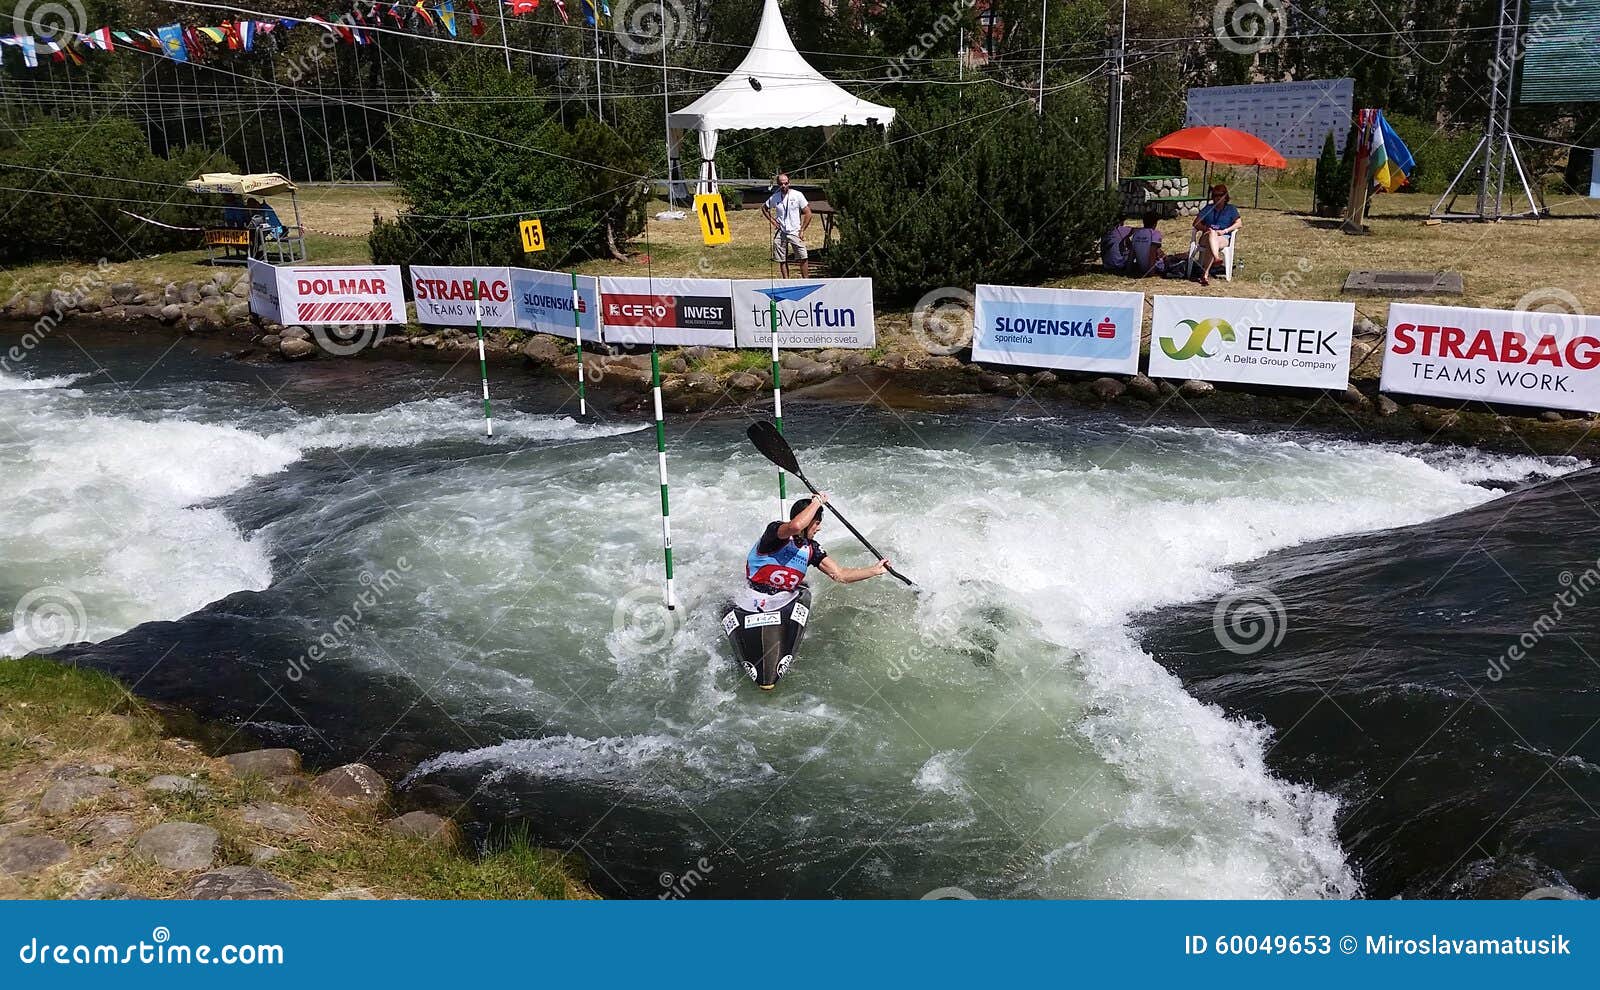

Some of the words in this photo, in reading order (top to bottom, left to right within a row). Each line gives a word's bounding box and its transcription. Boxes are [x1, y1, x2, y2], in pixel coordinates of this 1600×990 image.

[701, 202, 725, 236] 14
[524, 225, 541, 246] 15
[297, 279, 387, 296] DOLMAR
[415, 279, 509, 302] STRABAG
[429, 303, 463, 316] TEAMS
[683, 306, 724, 319] INVEST
[995, 317, 1095, 338] SLOVENSKÁ
[754, 335, 787, 344] Leteky
[789, 335, 802, 344] do
[834, 335, 858, 344] sveta
[1247, 326, 1338, 356] ELTEK
[1391, 323, 1600, 370] STRABAG
[1224, 354, 1232, 363] A
[1233, 355, 1257, 365] Delta
[1259, 356, 1289, 367] Group
[1291, 358, 1337, 371] Company
[1412, 362, 1486, 384] TEAMS
[1497, 370, 1575, 393] WORK.
[769, 569, 800, 590] 63
